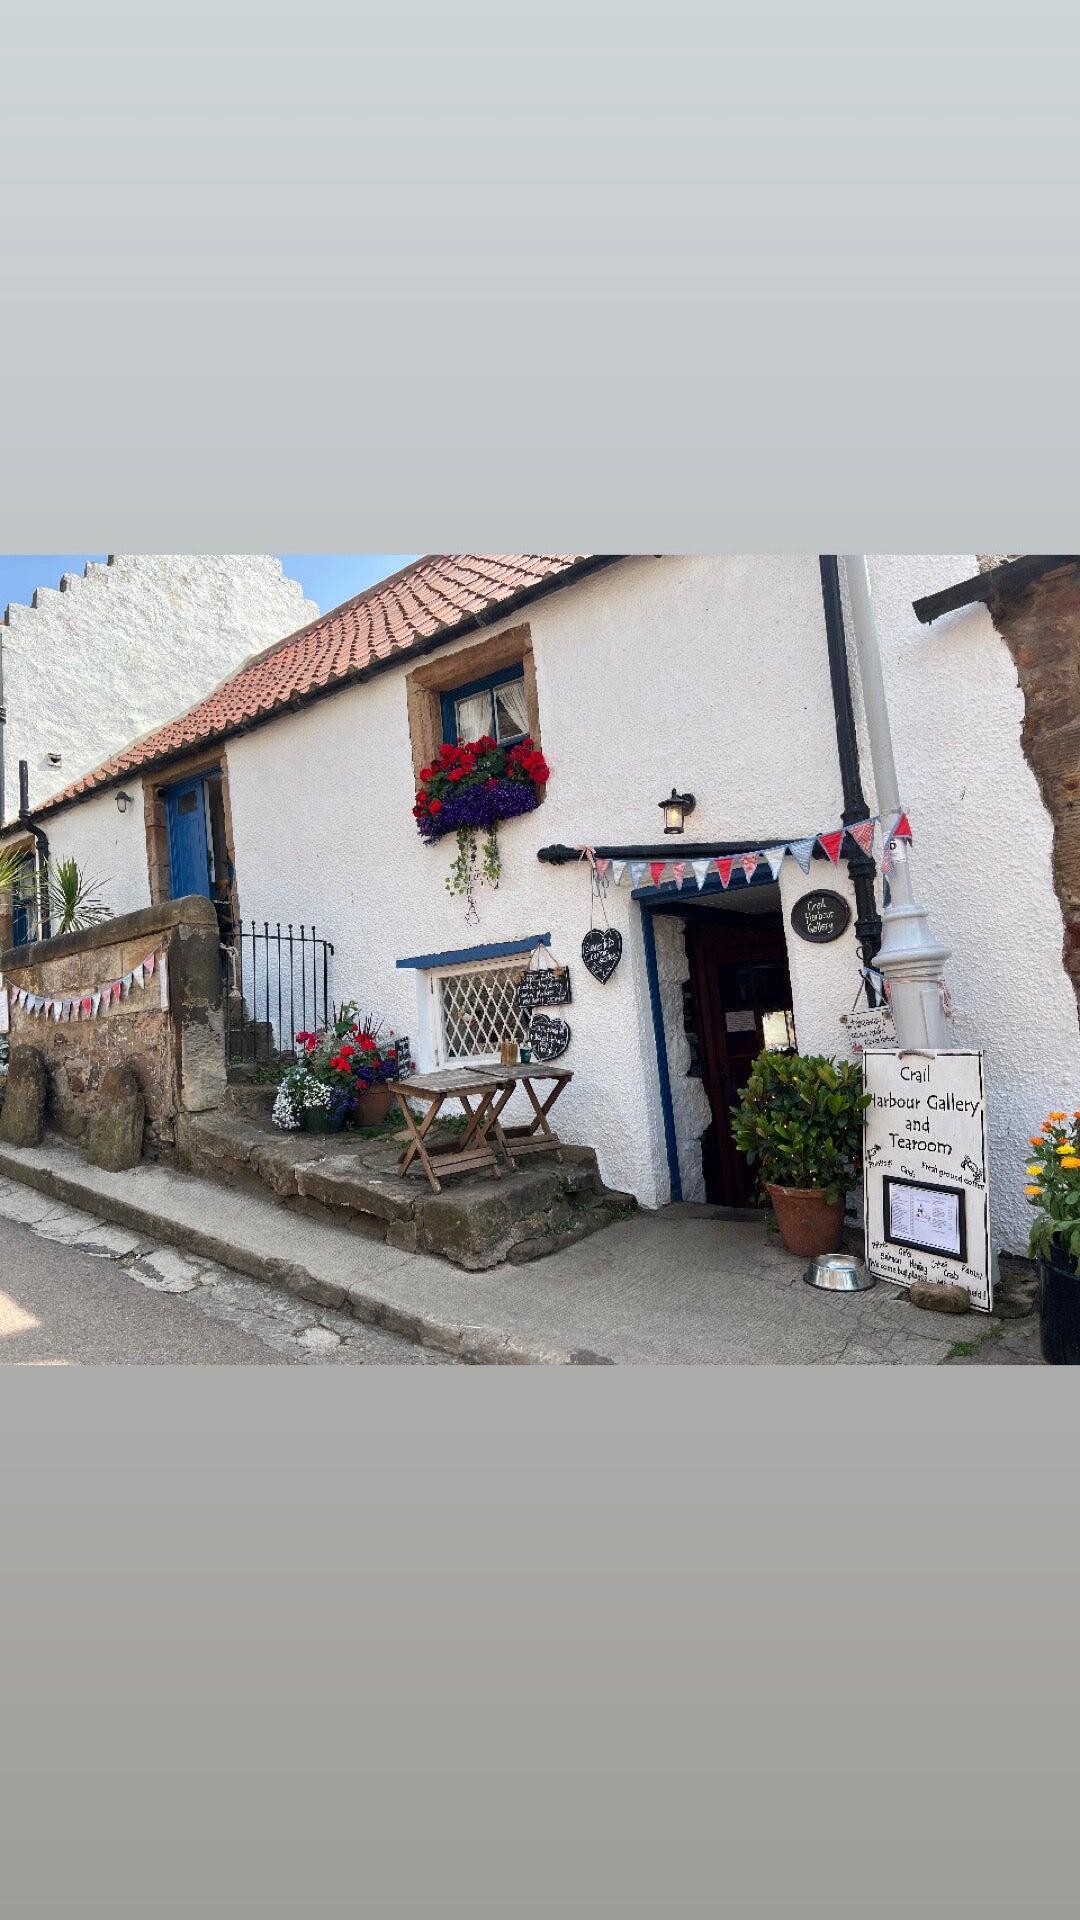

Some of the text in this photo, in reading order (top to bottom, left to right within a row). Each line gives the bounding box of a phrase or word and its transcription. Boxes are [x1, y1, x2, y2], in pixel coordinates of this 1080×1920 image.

[807, 898, 827, 911] Crail
[900, 1064, 930, 1083] Crail
[926, 1093, 980, 1118] Gallery
[905, 1116, 930, 1133] and
[888, 1132, 953, 1156] Tearoom
[938, 1169, 963, 1183] ground
[943, 1269, 959, 1280] Crab
